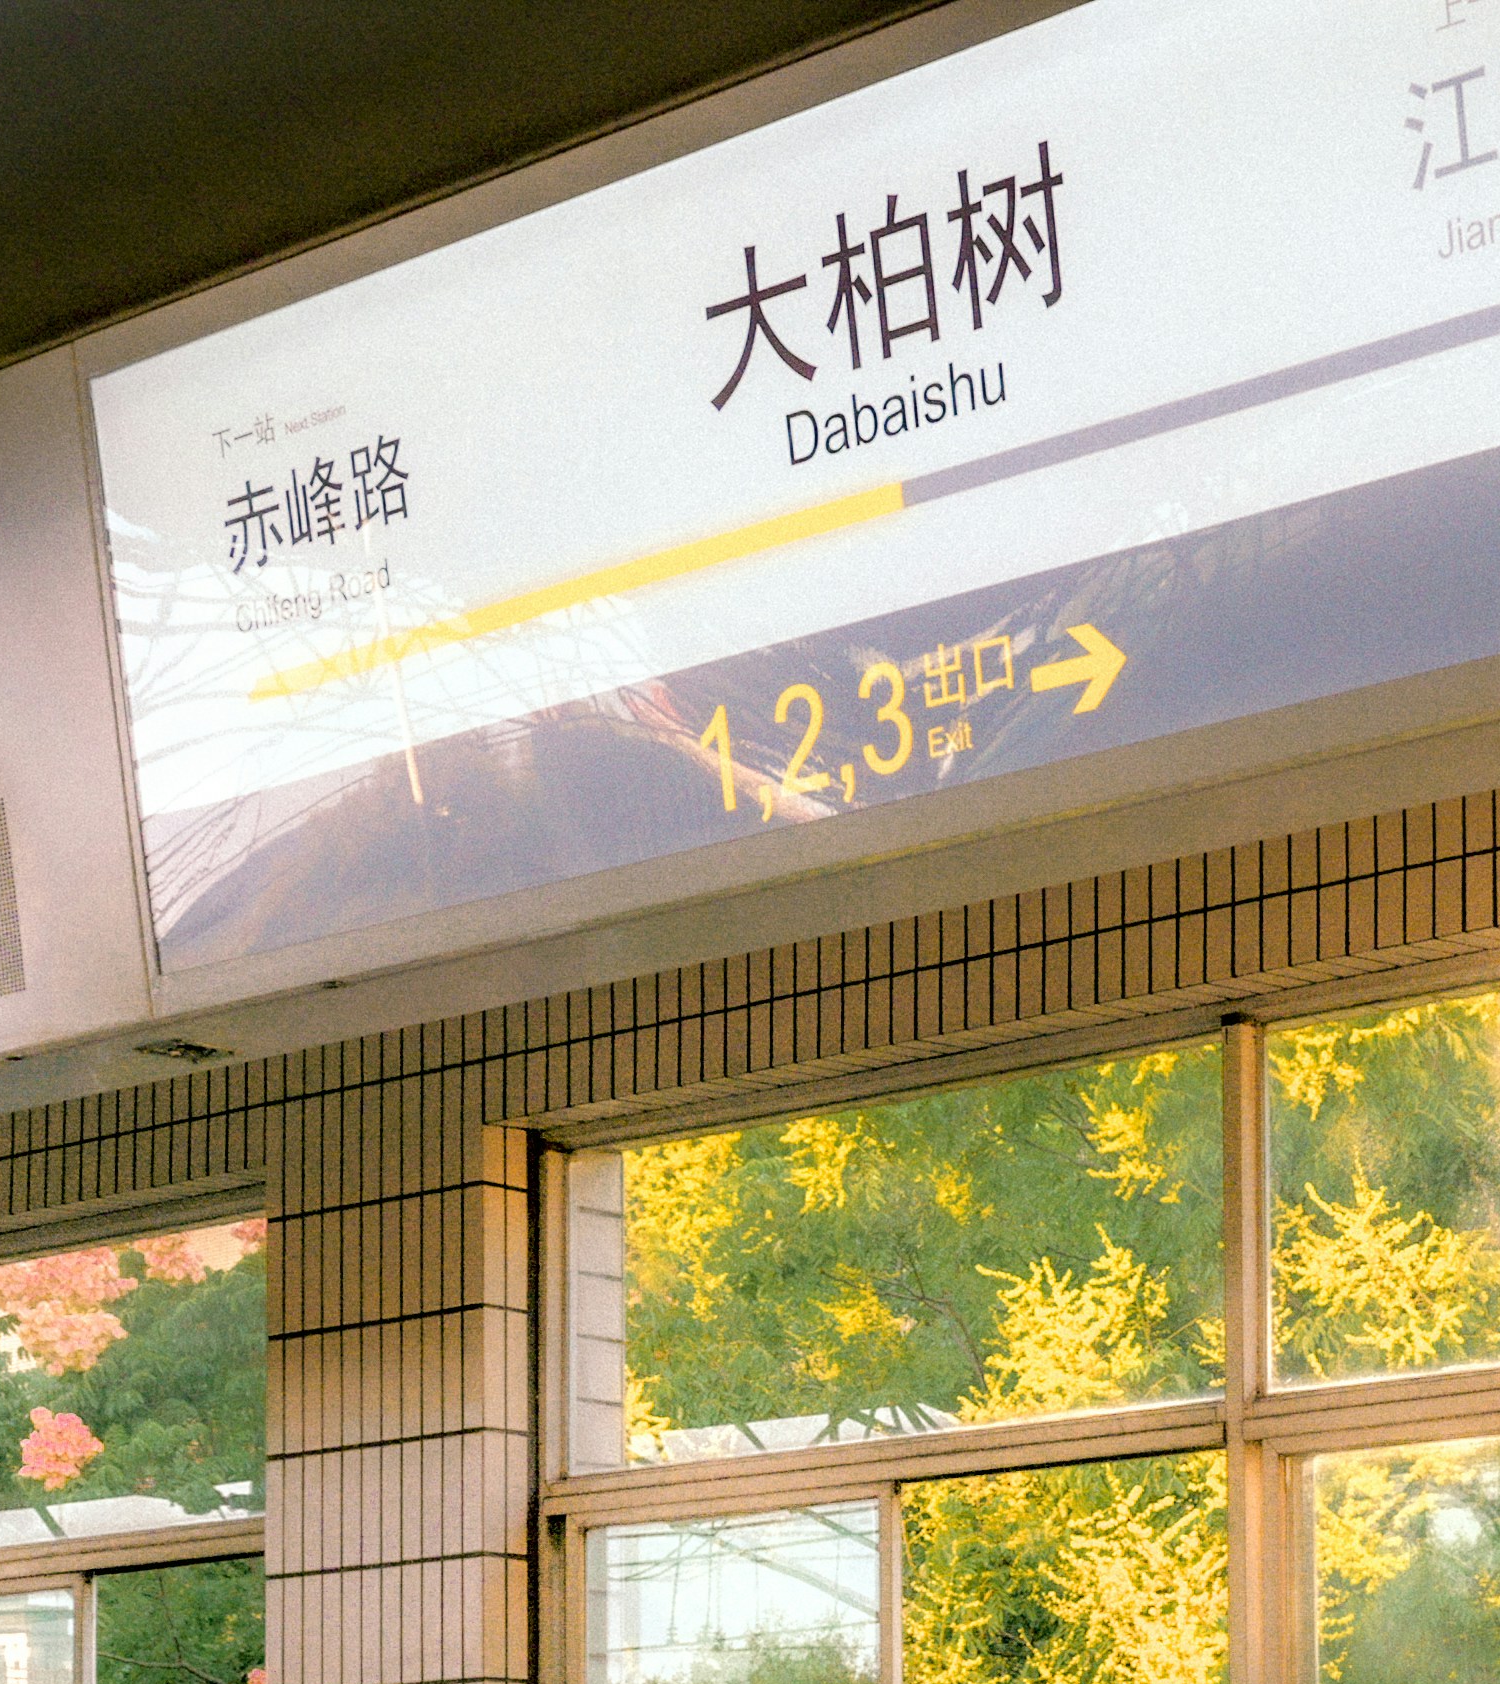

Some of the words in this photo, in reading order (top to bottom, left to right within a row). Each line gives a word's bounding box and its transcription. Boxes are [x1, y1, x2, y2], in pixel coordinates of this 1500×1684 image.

[706, 140, 1063, 411] 大柏树
[212, 412, 275, 458] 下一站
[284, 417, 311, 436] Next
[310, 404, 347, 428] Station
[786, 362, 1006, 466] Dabaishu
[225, 435, 409, 575] 赤峰路
[236, 589, 322, 633] Chifeng
[329, 558, 390, 602] Road
[700, 661, 914, 823] 1,2,3
[923, 635, 1014, 708] 出口
[927, 721, 973, 759] Exit
